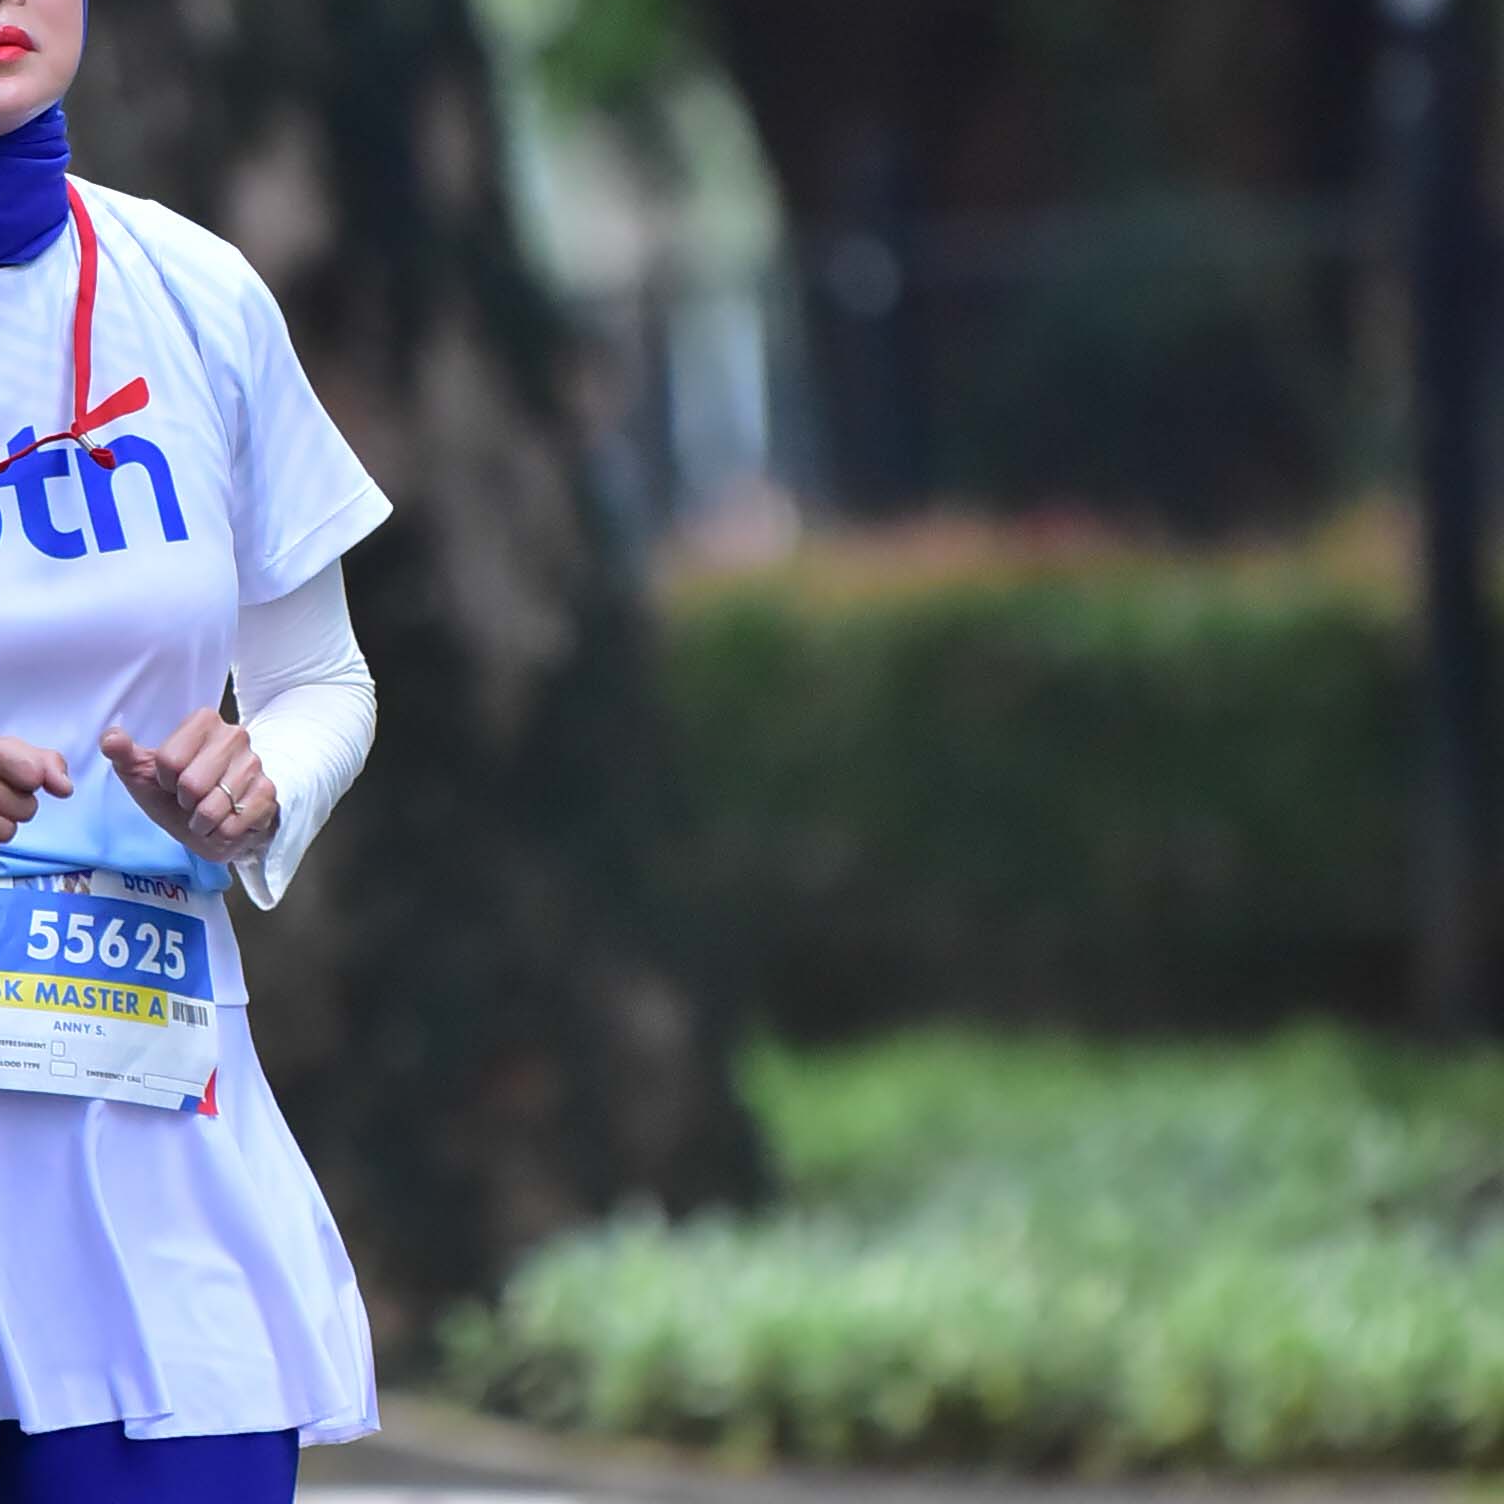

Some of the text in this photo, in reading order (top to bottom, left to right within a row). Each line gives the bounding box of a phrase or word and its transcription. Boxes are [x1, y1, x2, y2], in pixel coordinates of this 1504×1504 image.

[26, 909, 187, 980] 55625
[35, 982, 141, 1020] MASTER
[148, 996, 166, 1020] A
[53, 1019, 107, 1037] ANNY S.
